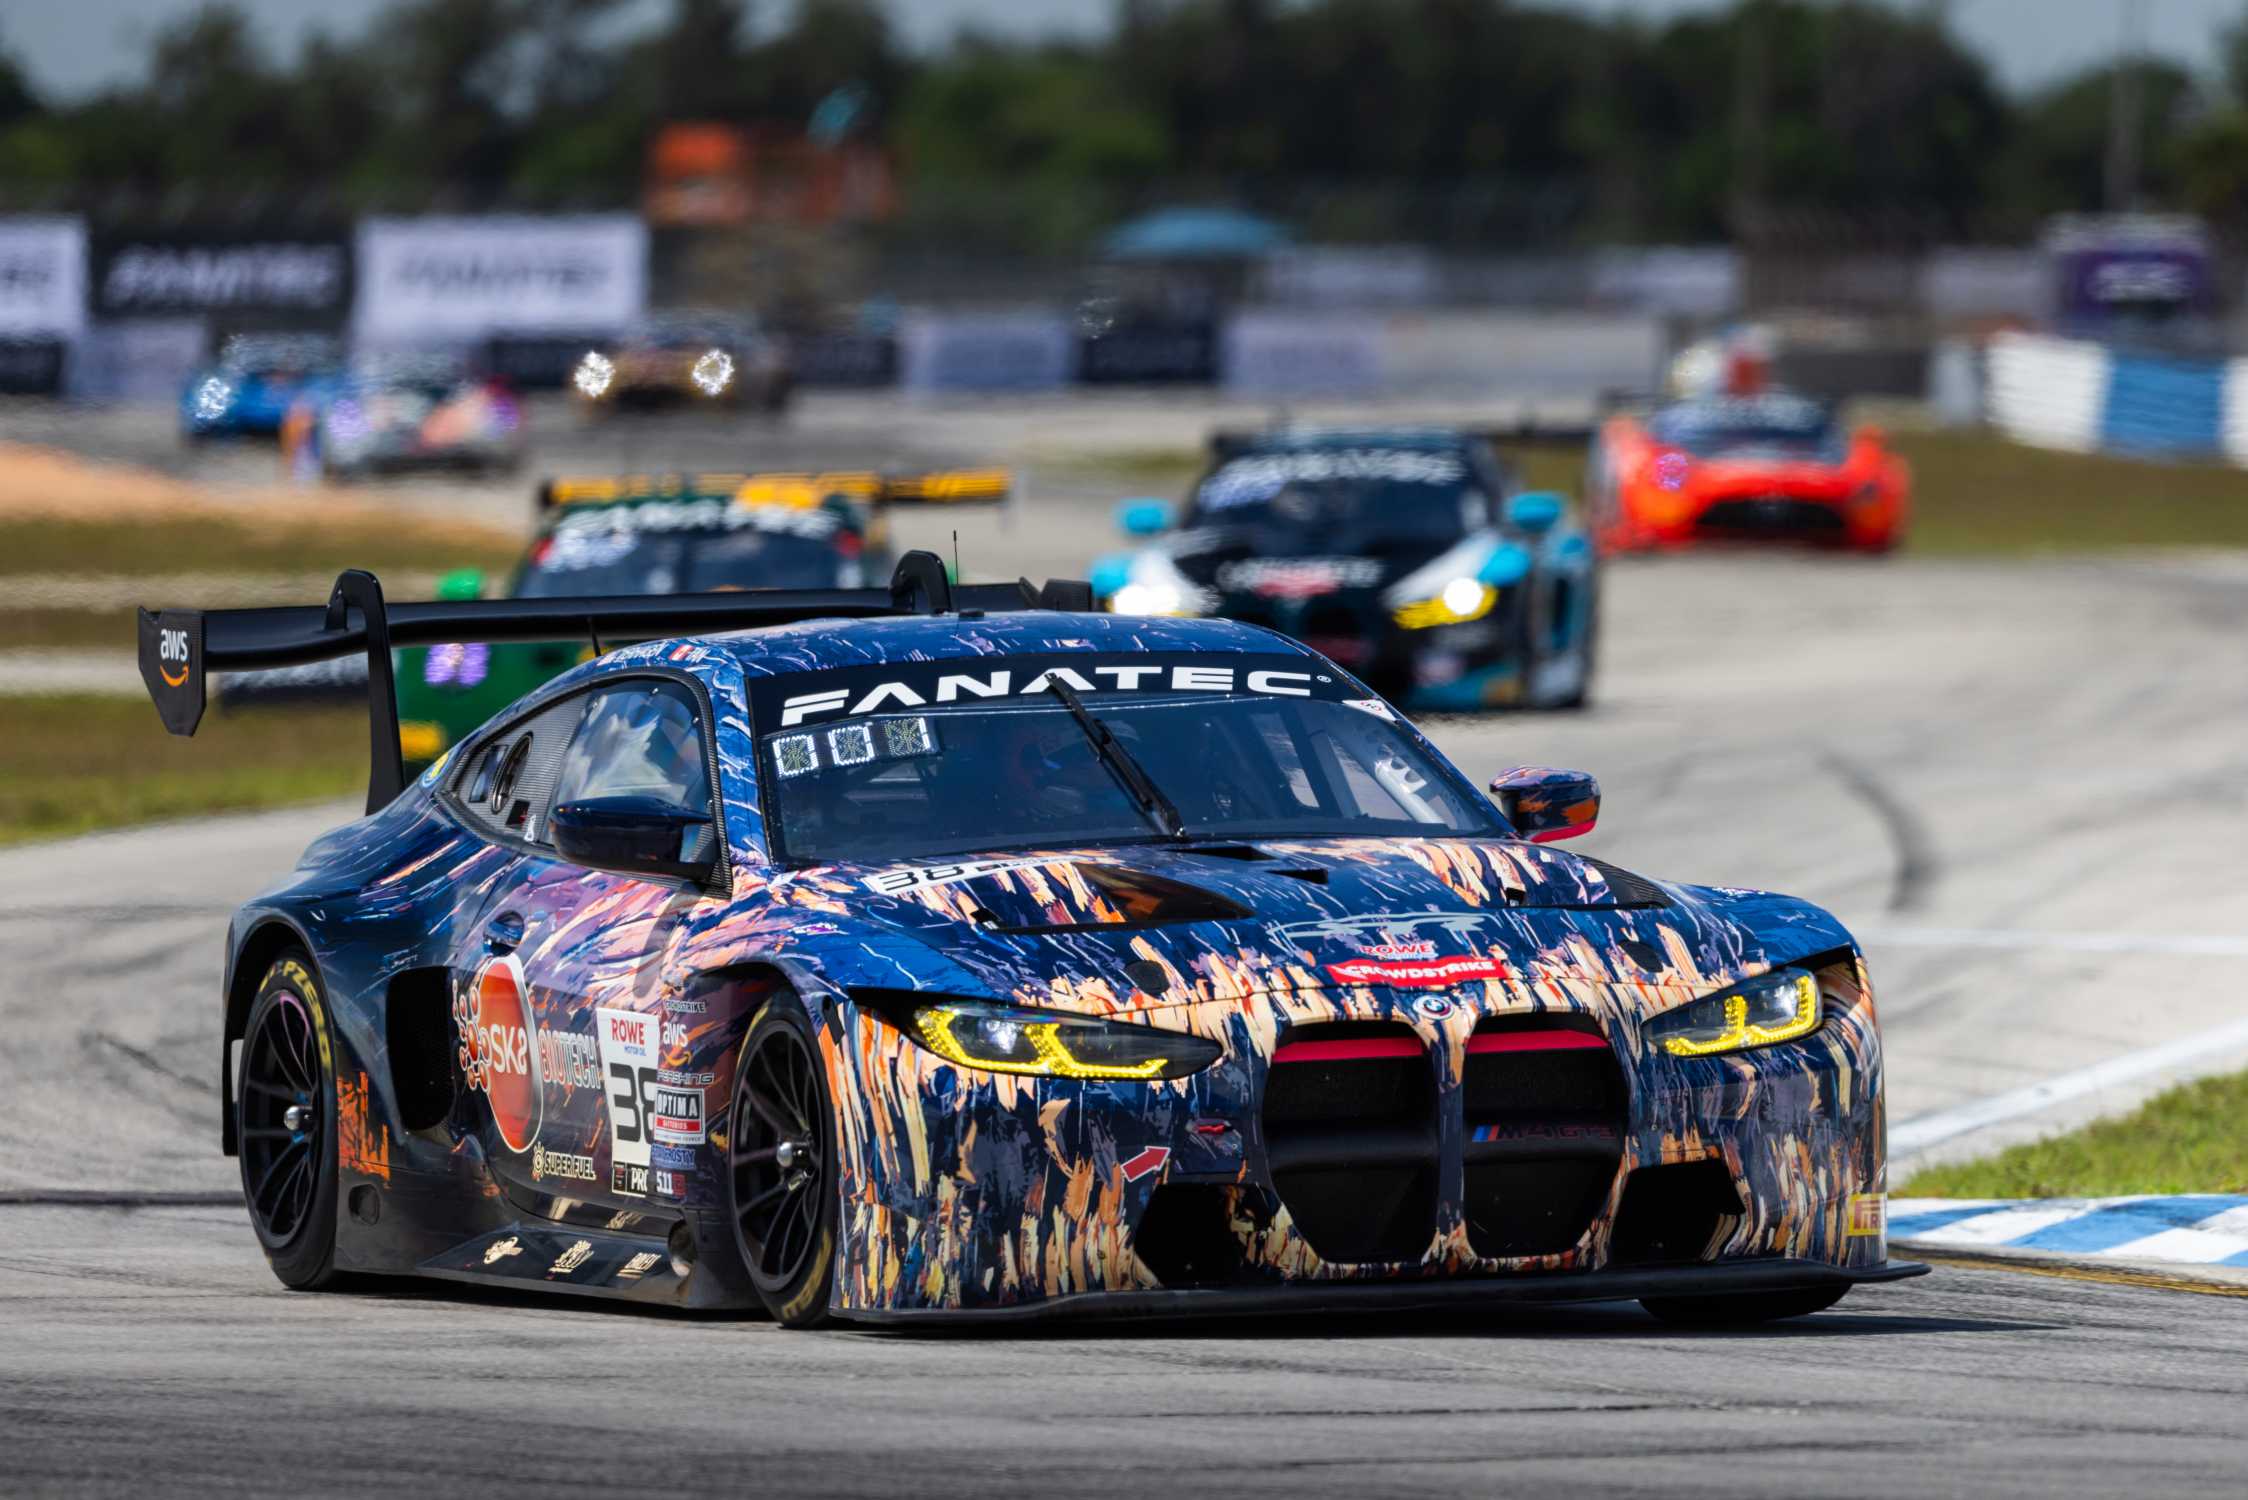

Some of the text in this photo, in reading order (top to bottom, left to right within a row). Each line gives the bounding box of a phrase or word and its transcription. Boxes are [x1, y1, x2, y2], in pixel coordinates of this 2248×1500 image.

[160, 628, 188, 661] aws
[780, 666, 1312, 727] FANATEC
[1346, 961, 1496, 979] CROWDSTRIKE
[611, 1018, 646, 1046] ROWE
[662, 1021, 688, 1048] aws
[657, 1093, 699, 1117] OPTIMA
